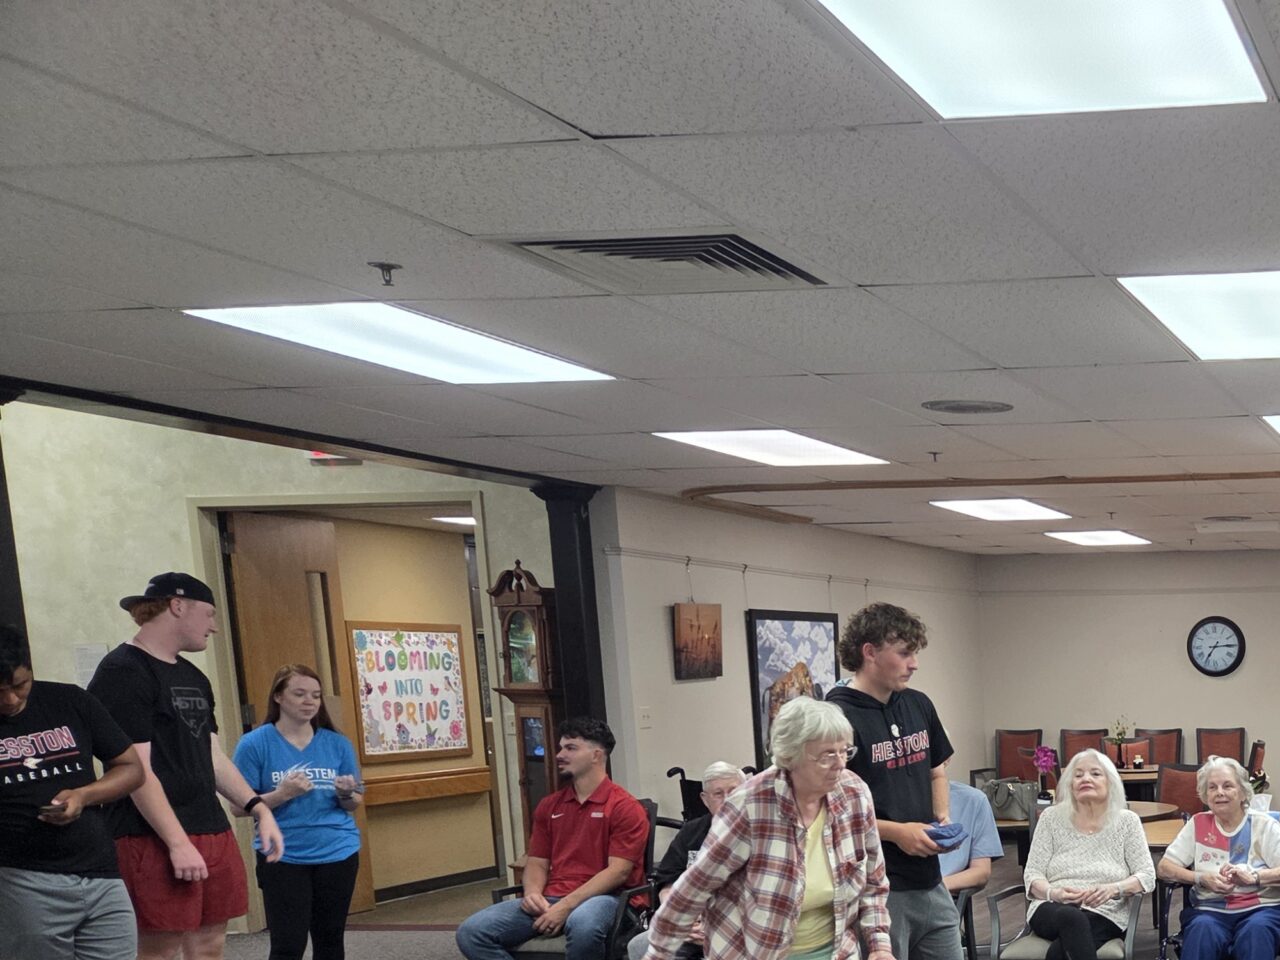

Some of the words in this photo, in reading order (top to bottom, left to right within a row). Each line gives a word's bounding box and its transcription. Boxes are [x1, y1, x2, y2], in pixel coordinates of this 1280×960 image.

[365, 650, 452, 672] BLOOMING
[395, 679, 423, 697] INTO
[382, 700, 450, 726] SPRING
[0, 726, 76, 760] ESSTON
[4, 763, 83, 784] ASEBALL
